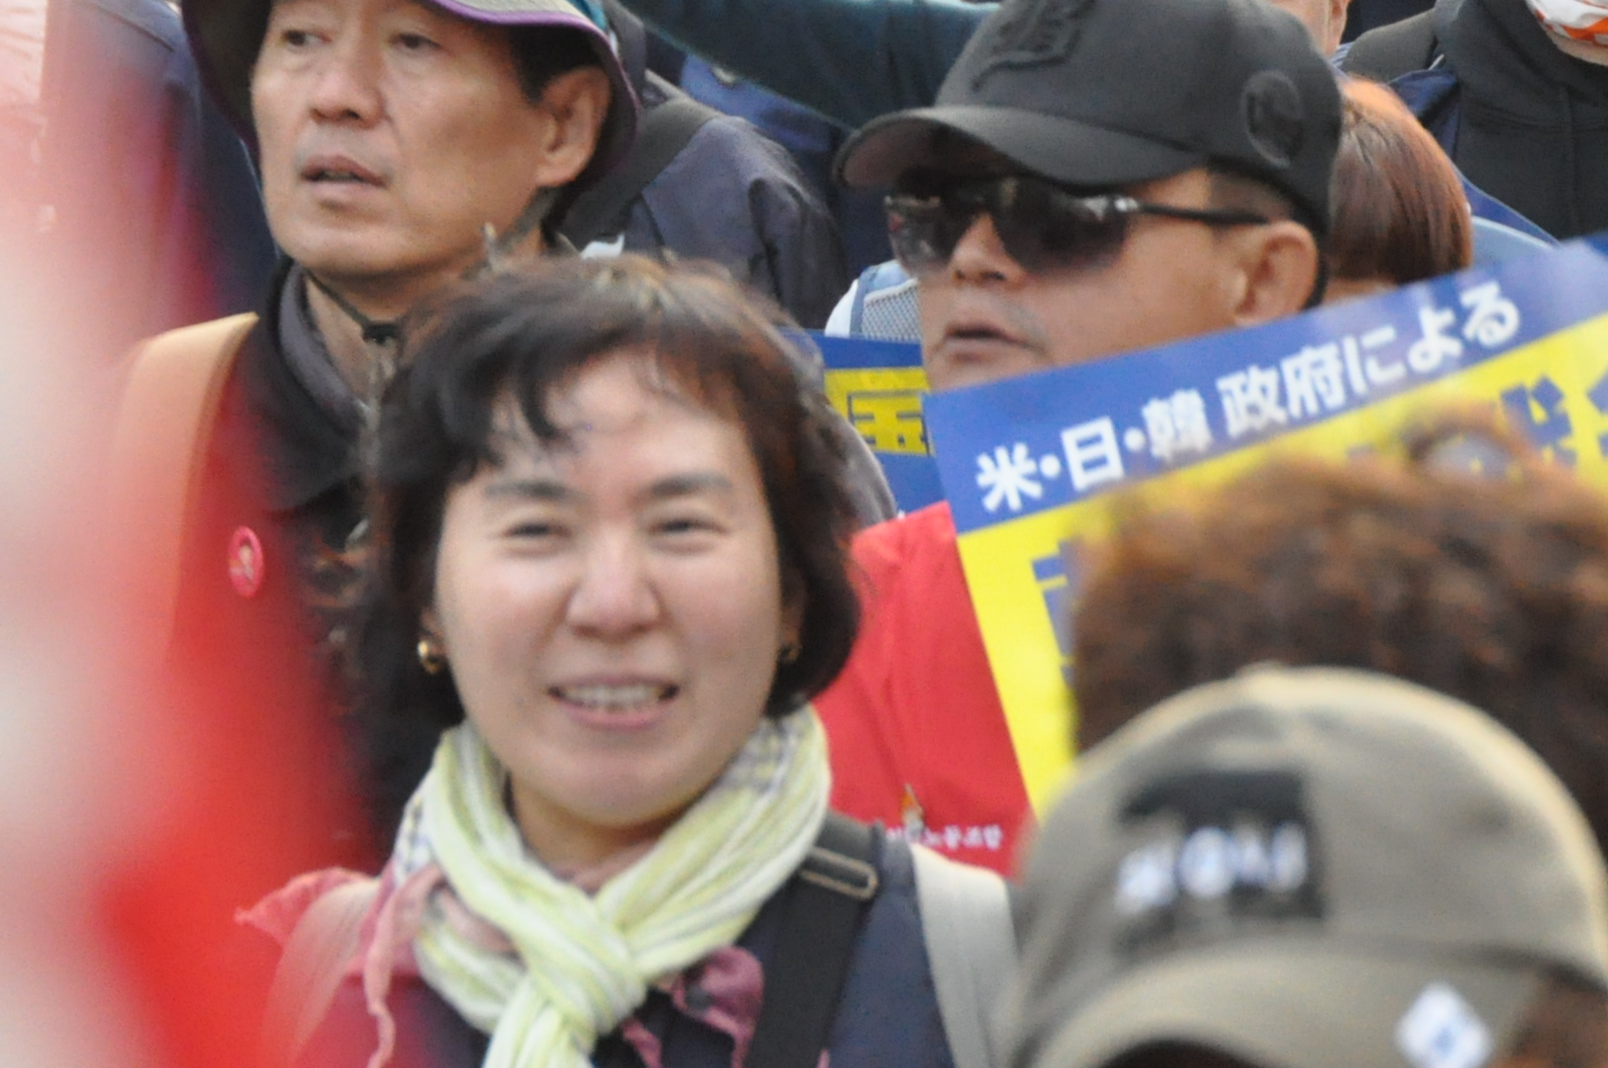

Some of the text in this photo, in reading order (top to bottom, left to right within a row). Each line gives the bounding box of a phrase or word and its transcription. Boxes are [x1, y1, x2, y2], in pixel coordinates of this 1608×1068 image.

[1215, 279, 1521, 439] 政府による
